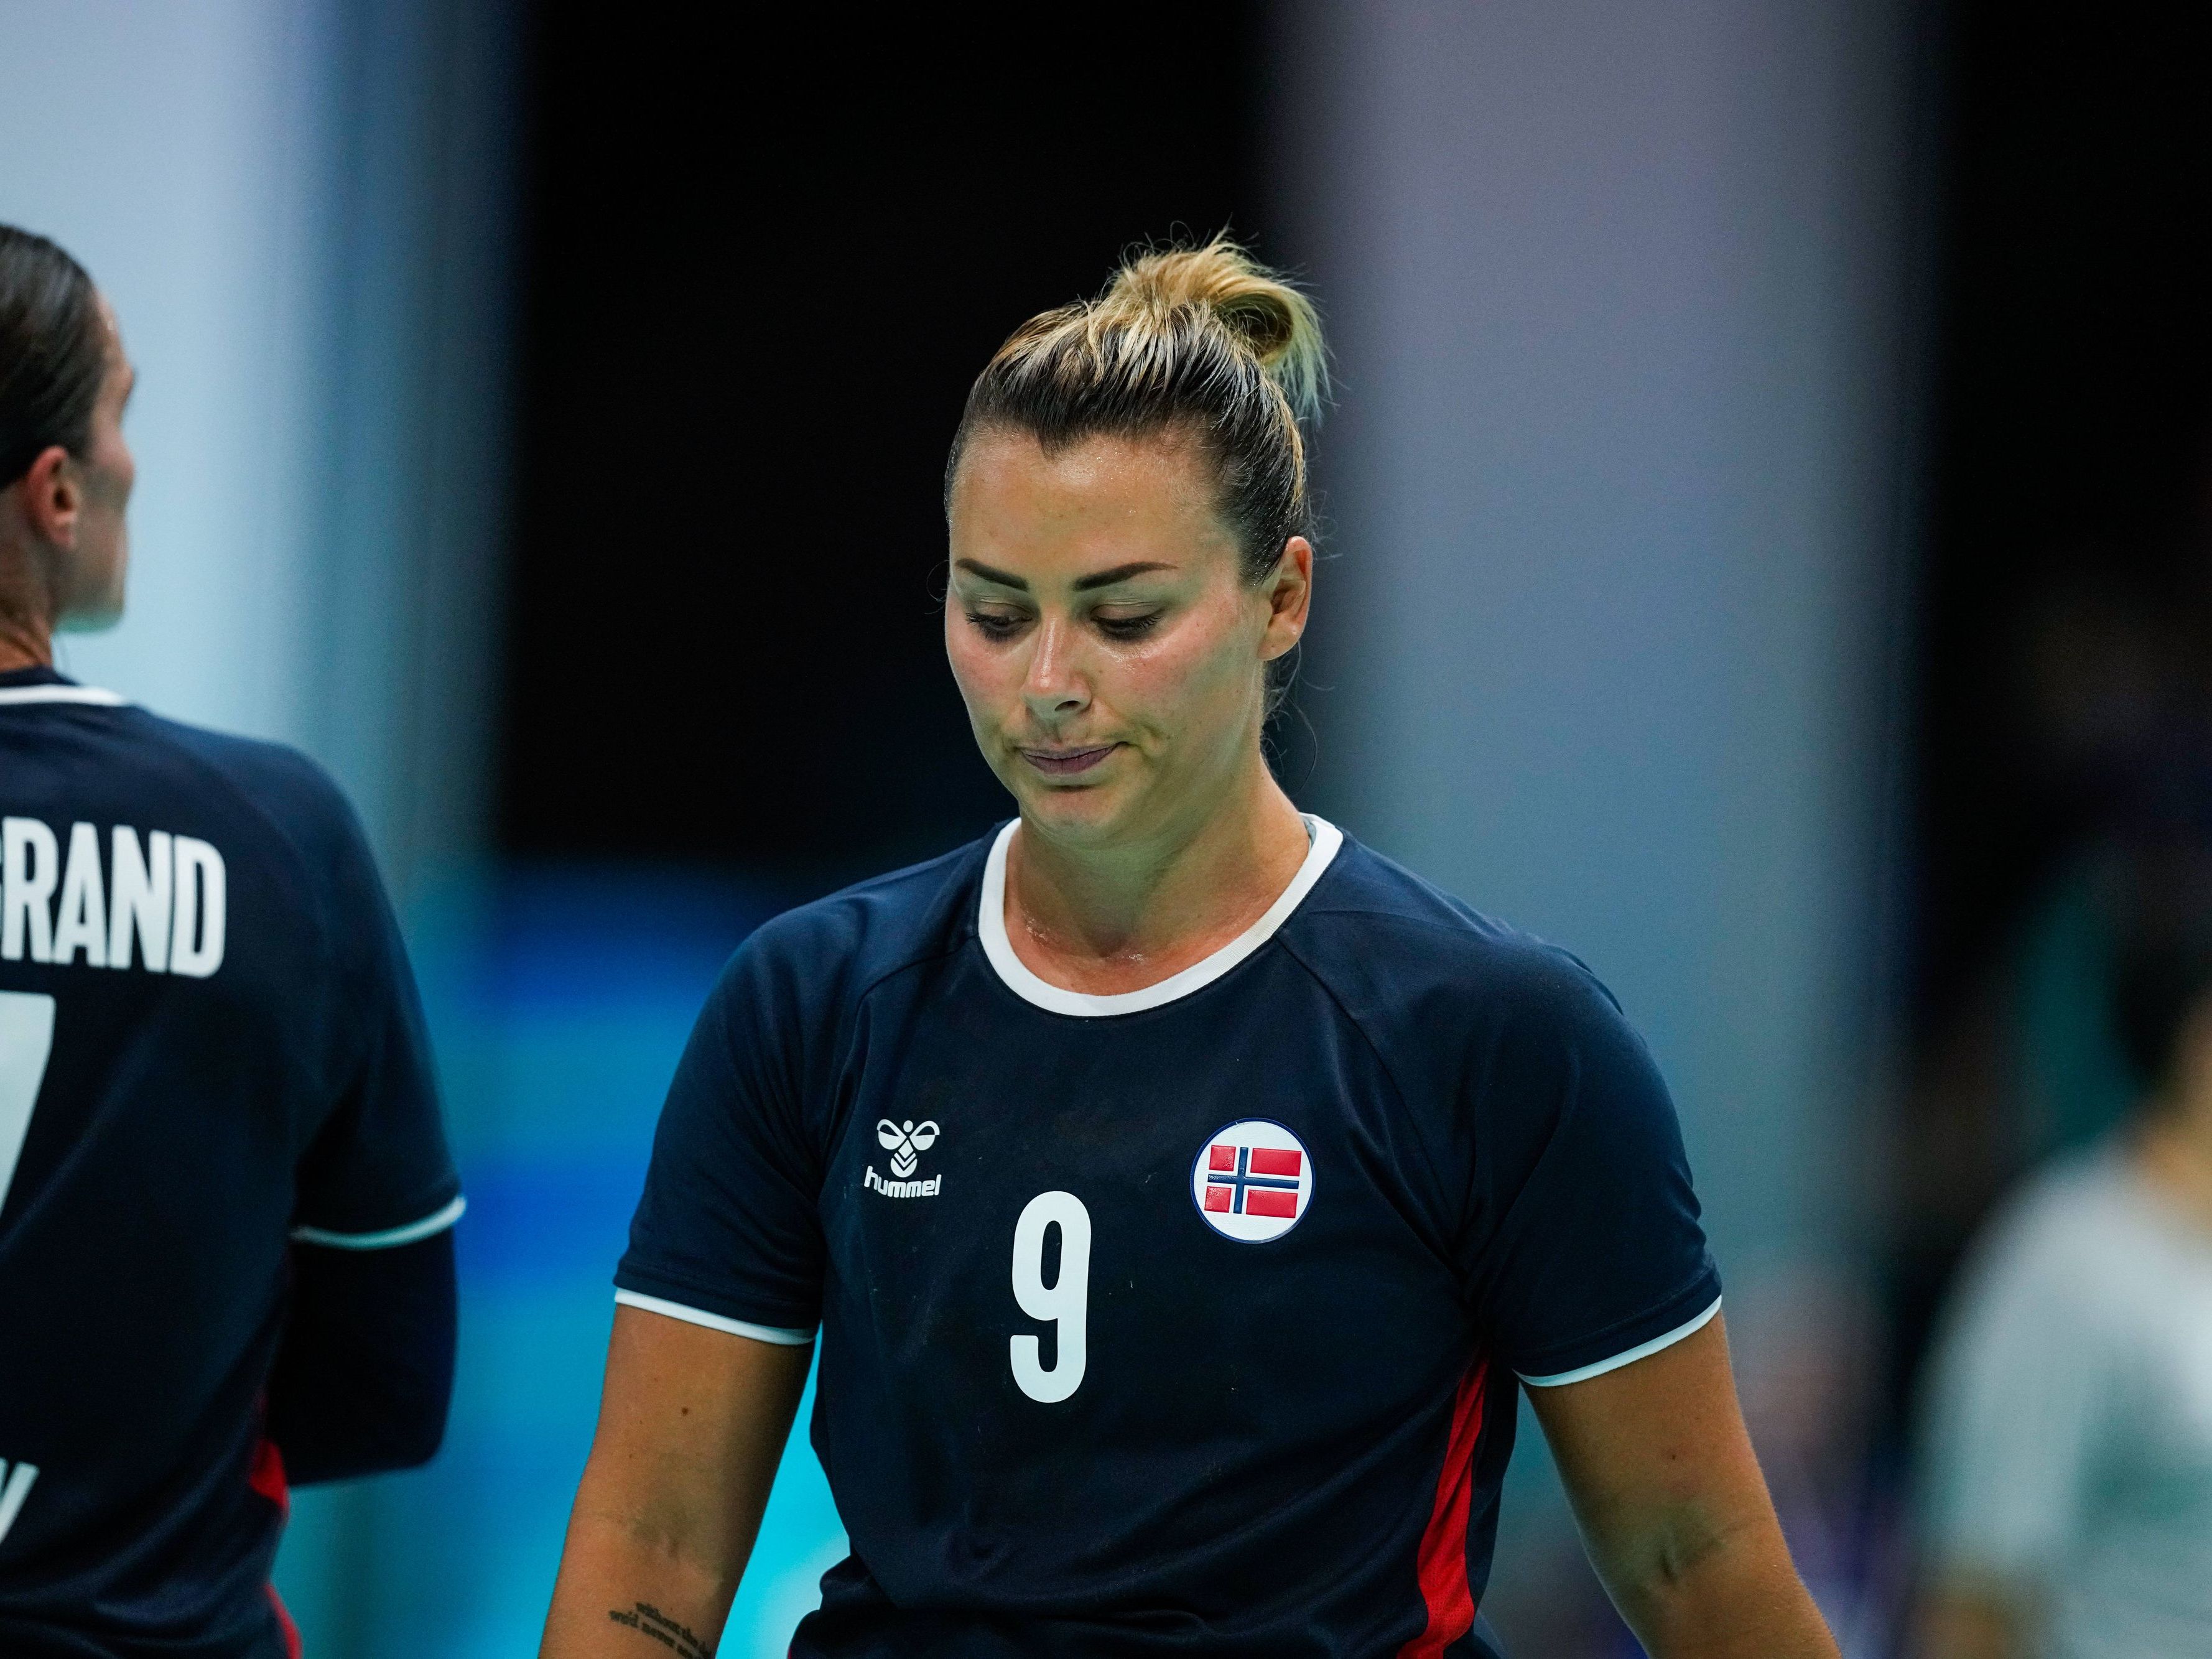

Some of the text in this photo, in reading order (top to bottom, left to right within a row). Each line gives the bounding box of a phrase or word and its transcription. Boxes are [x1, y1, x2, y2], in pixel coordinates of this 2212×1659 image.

[0, 816, 227, 979] RAND
[863, 1165, 942, 1198] hummel
[1010, 1191, 1092, 1403] 9
